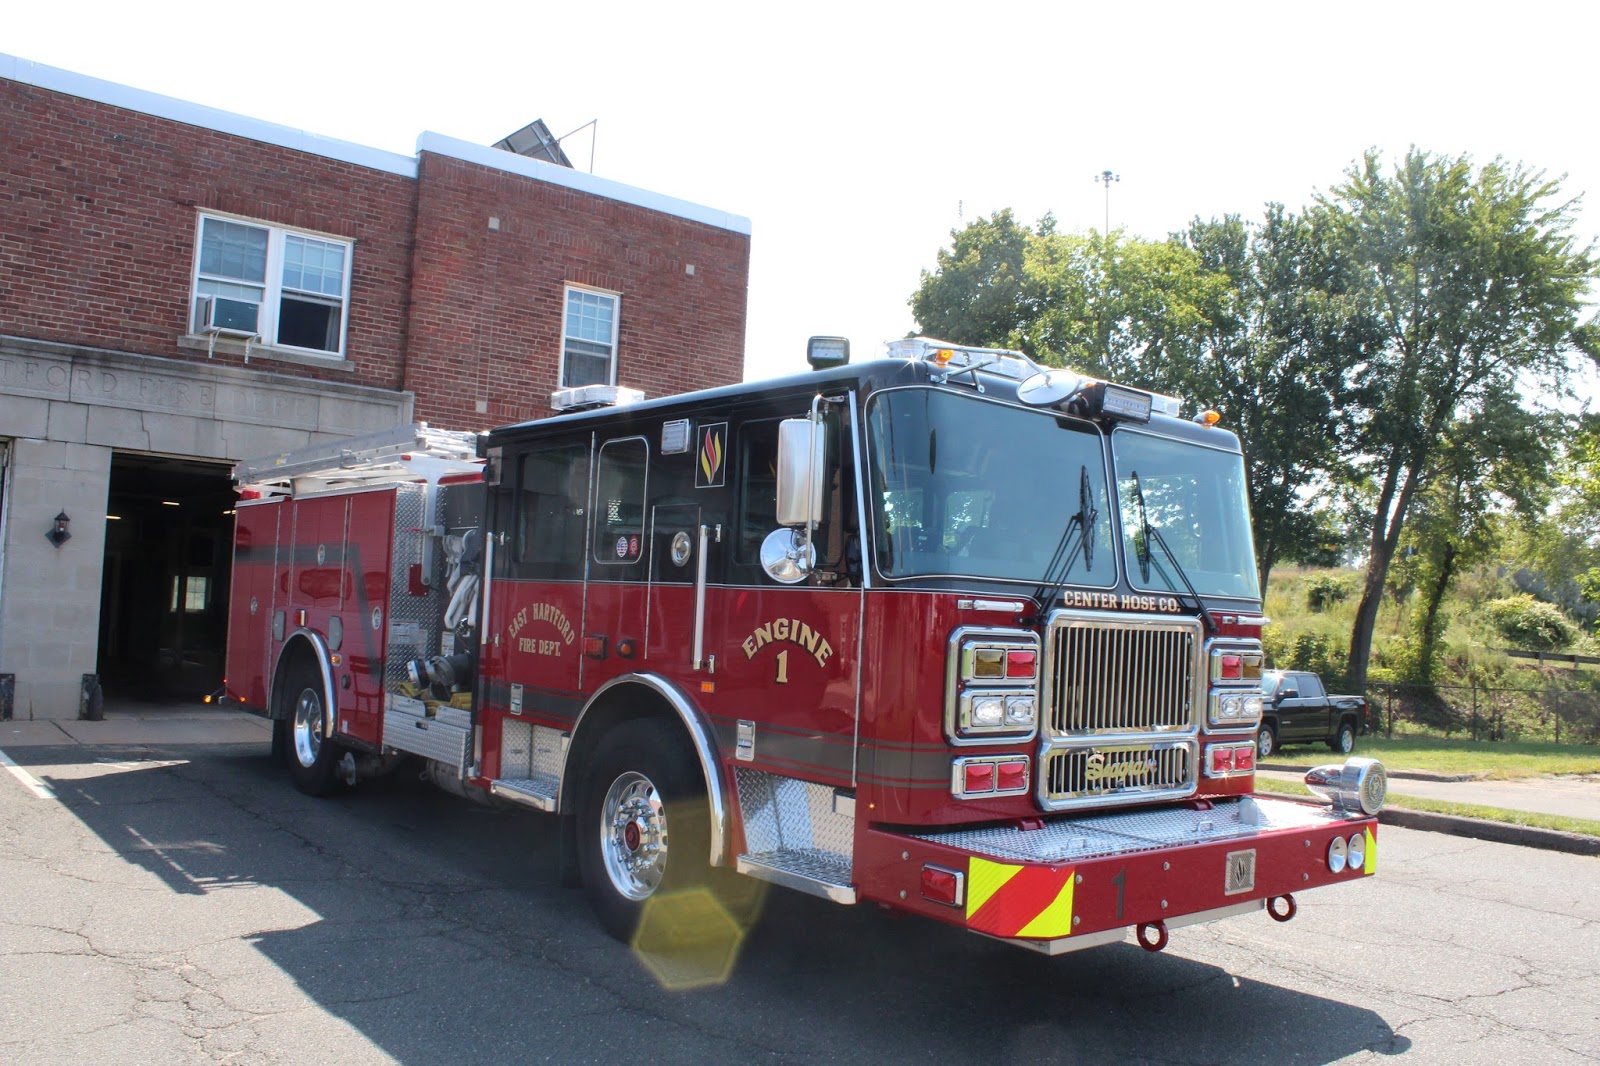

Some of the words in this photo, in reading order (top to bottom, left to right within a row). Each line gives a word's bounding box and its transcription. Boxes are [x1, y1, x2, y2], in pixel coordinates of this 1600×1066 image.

[138, 376, 213, 406] FIRE
[1064, 591, 1118, 609] CENTER
[1121, 595, 1157, 611] HOSE
[1159, 598, 1181, 613] CO.
[508, 607, 527, 639] EAST
[533, 603, 575, 645] HARTFORD
[519, 638, 536, 653] FIRE
[539, 640, 560, 657] DEPT.
[742, 618, 833, 668] ENGINE
[776, 650, 788, 683] 1
[1112, 867, 1126, 920] 1
